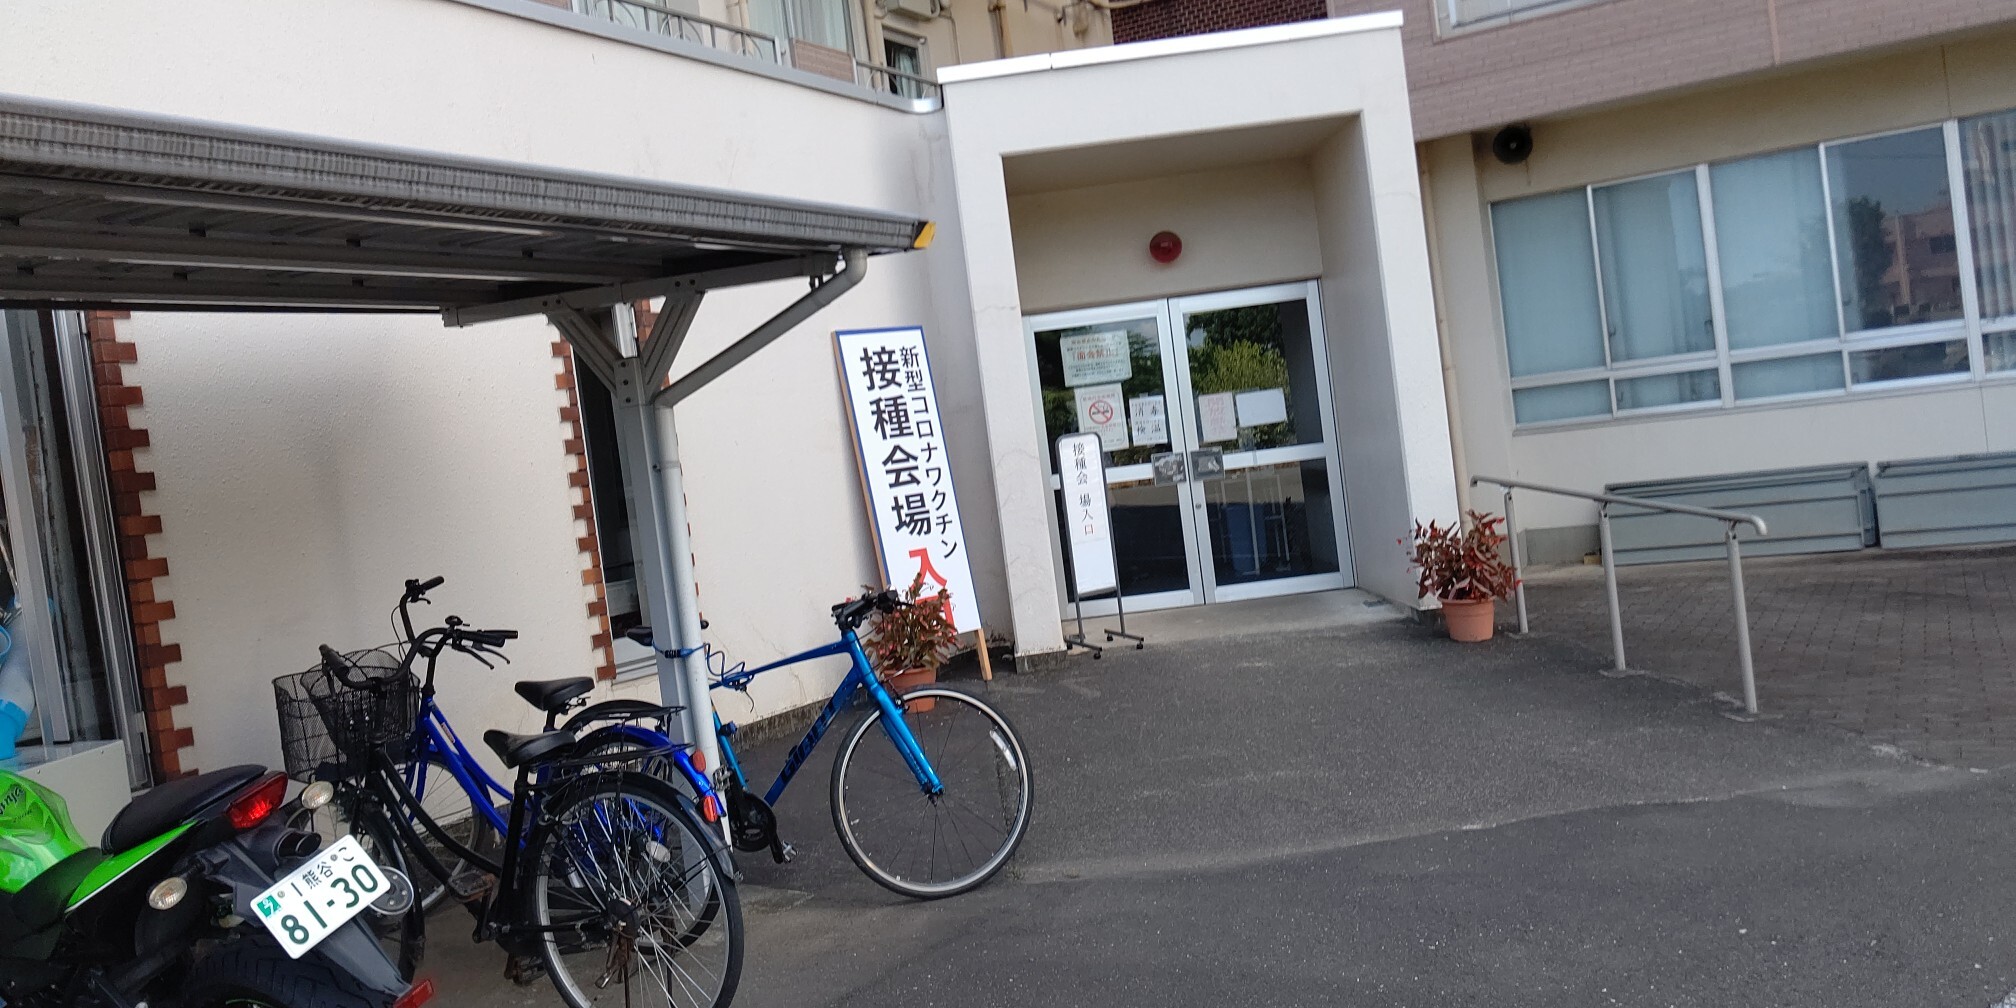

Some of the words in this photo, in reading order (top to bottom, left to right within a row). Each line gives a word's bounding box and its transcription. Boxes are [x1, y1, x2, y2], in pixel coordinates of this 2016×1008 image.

[899, 346, 958, 559] 新型コロナワクチン
[281, 864, 378, 945] 81-30
[302, 861, 333, 890] 熊谷
[338, 846, 355, 862] こ
